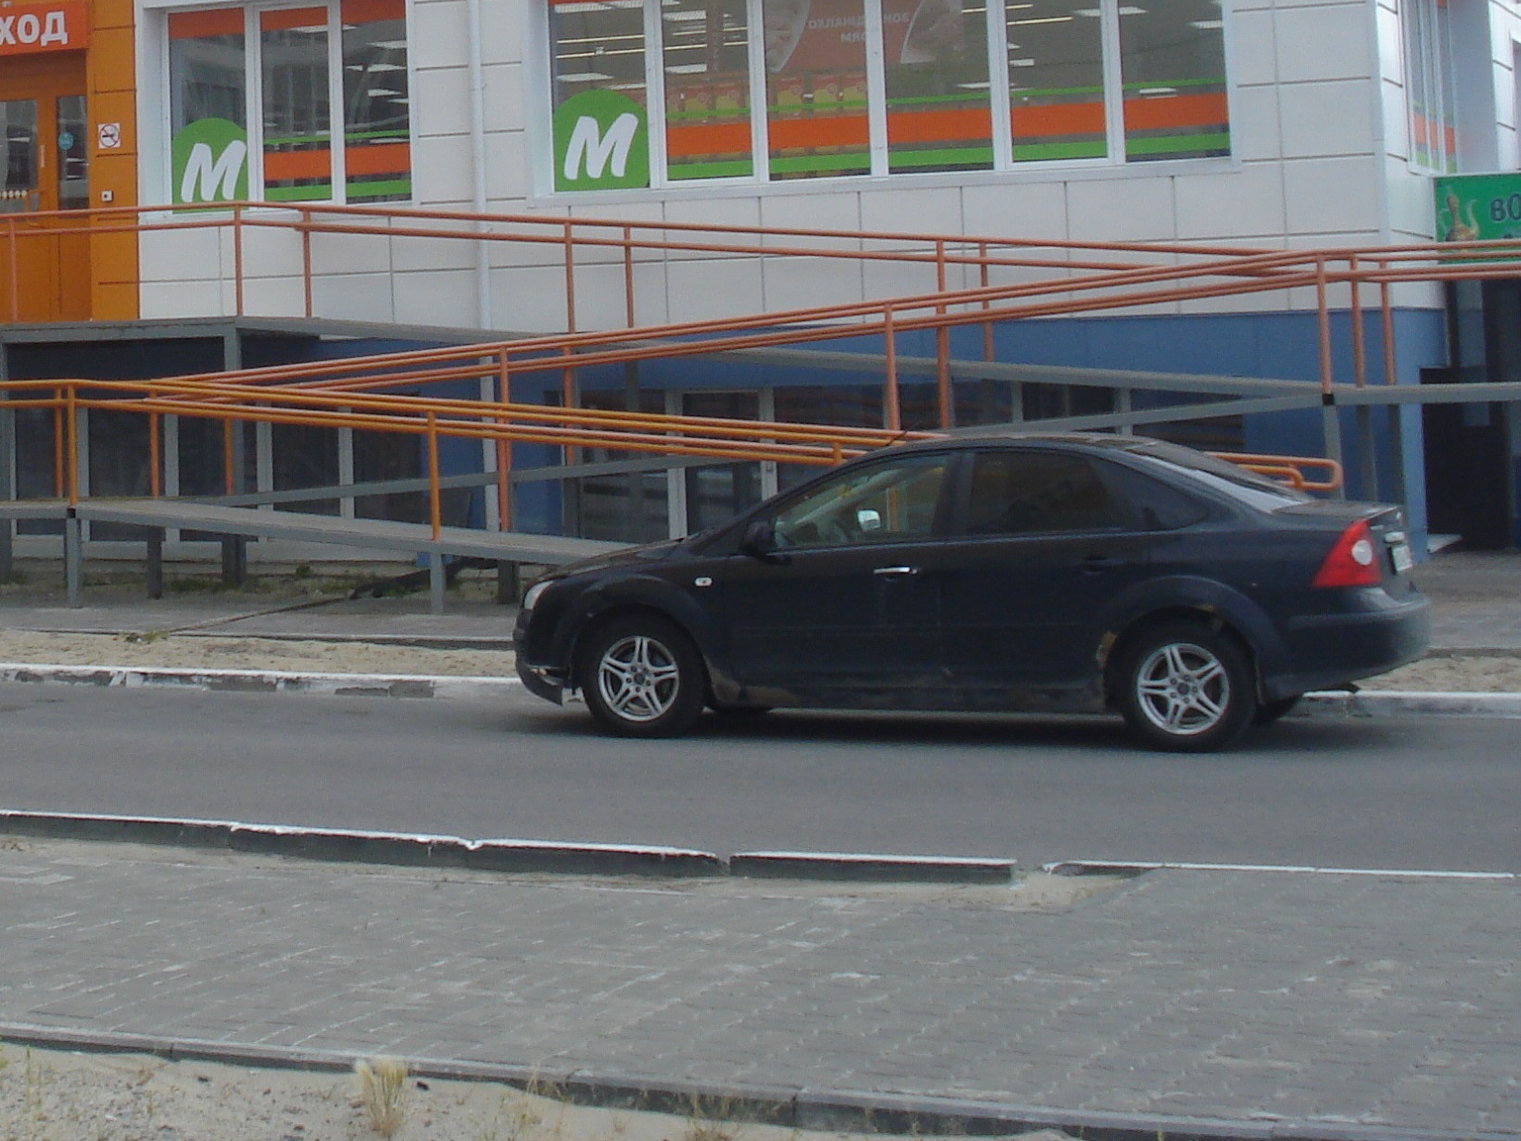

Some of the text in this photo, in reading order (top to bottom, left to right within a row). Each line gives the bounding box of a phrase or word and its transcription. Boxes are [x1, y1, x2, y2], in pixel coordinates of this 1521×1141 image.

[808, 13, 909, 29] ОХЛАЖДНОЕ
[180, 139, 246, 202] М
[563, 112, 638, 180] М
